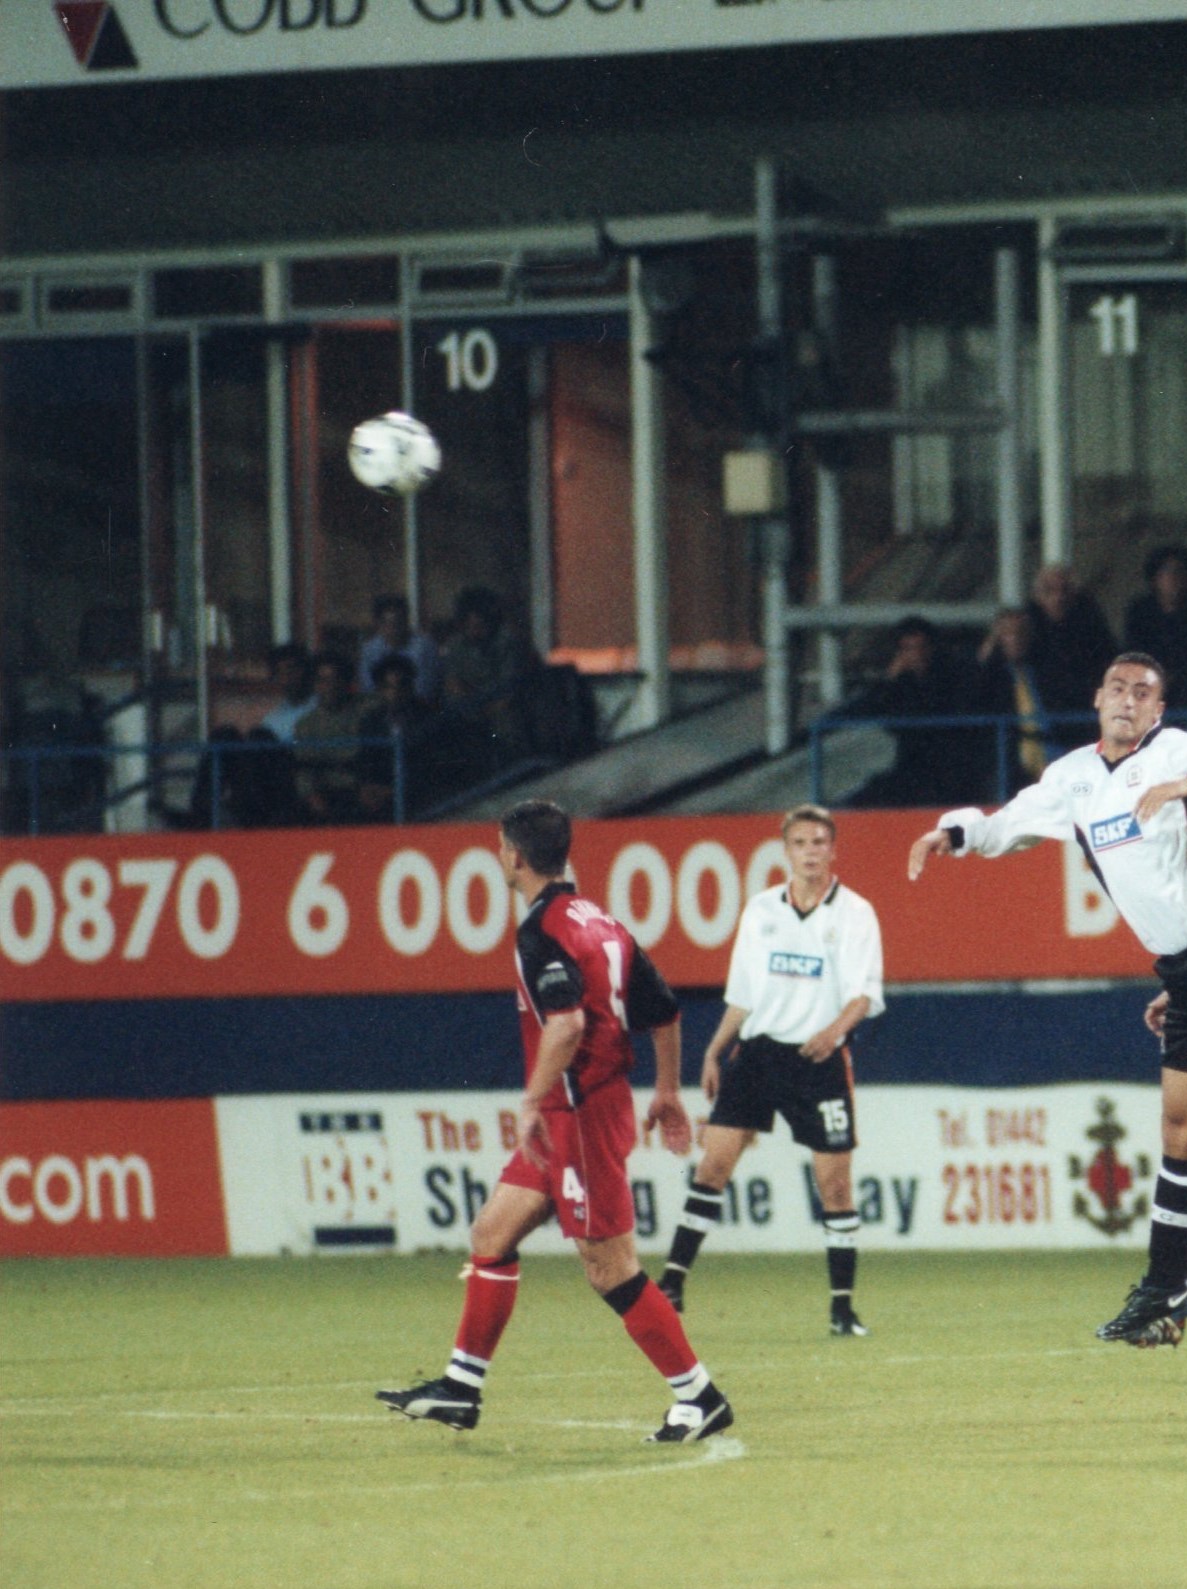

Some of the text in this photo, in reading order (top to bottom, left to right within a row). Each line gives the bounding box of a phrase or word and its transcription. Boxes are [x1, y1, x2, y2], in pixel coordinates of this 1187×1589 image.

[1089, 294, 1137, 354] 11
[437, 329, 498, 391] 10
[1093, 816, 1133, 847] SKF
[0, 855, 240, 965] 0870
[287, 851, 350, 958] 6
[416, 1109, 482, 1153] The
[816, 1099, 849, 1133] 15
[562, 1166, 586, 1202] 4
[942, 1162, 1052, 1225] 231681
